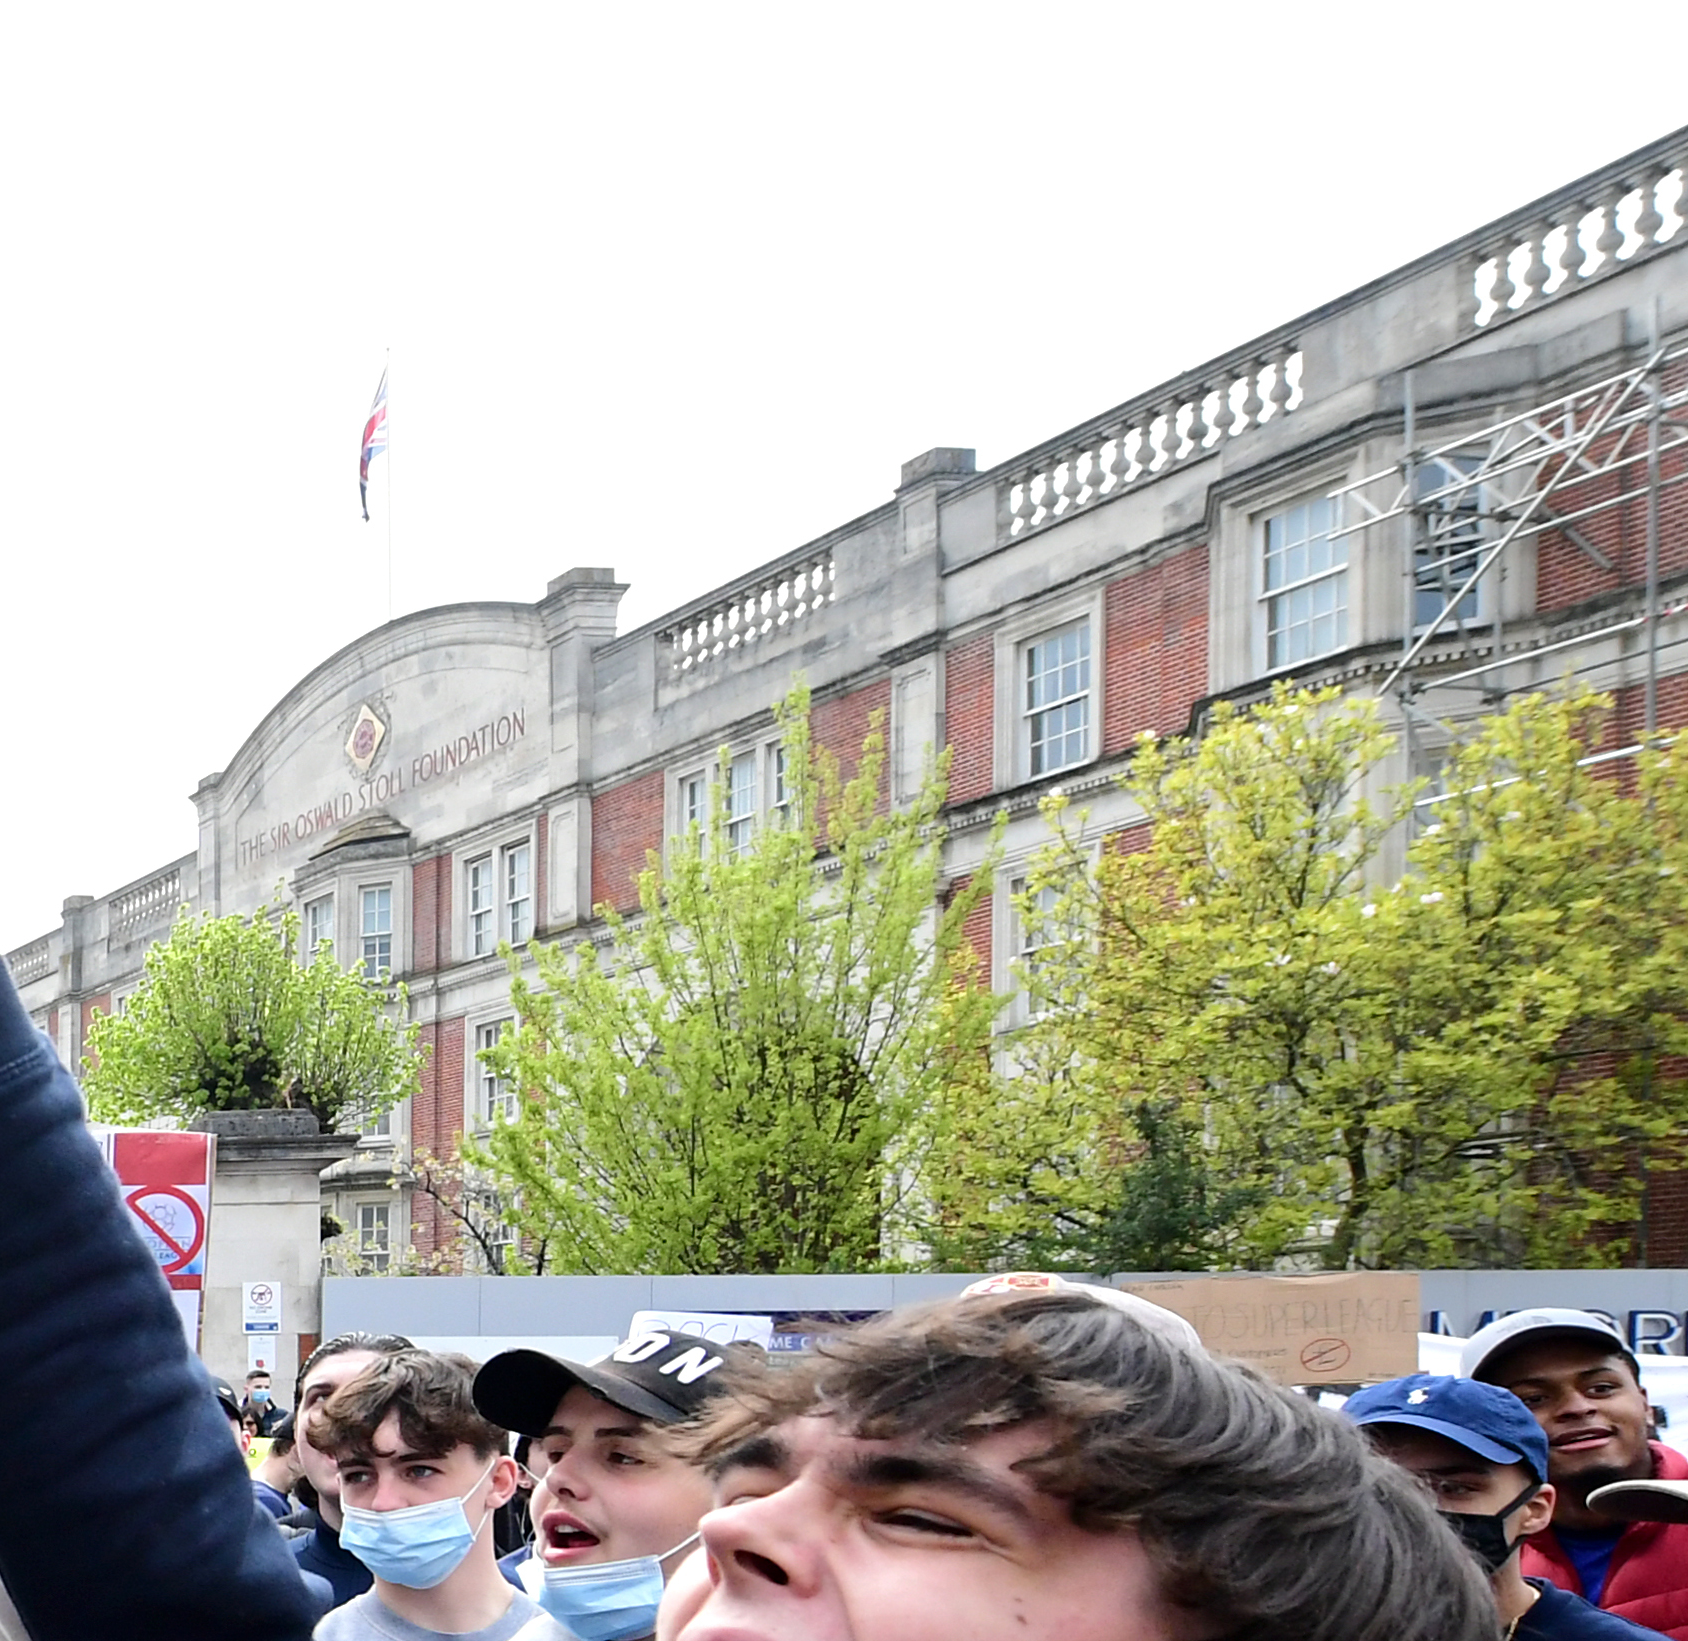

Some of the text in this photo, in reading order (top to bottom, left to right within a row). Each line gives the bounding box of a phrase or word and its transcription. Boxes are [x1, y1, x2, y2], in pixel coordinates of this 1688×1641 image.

[240, 708, 525, 866] THE SIR OSWALD STOLL FOUNDATION
[1323, 1298, 1418, 1334] LEAGUE
